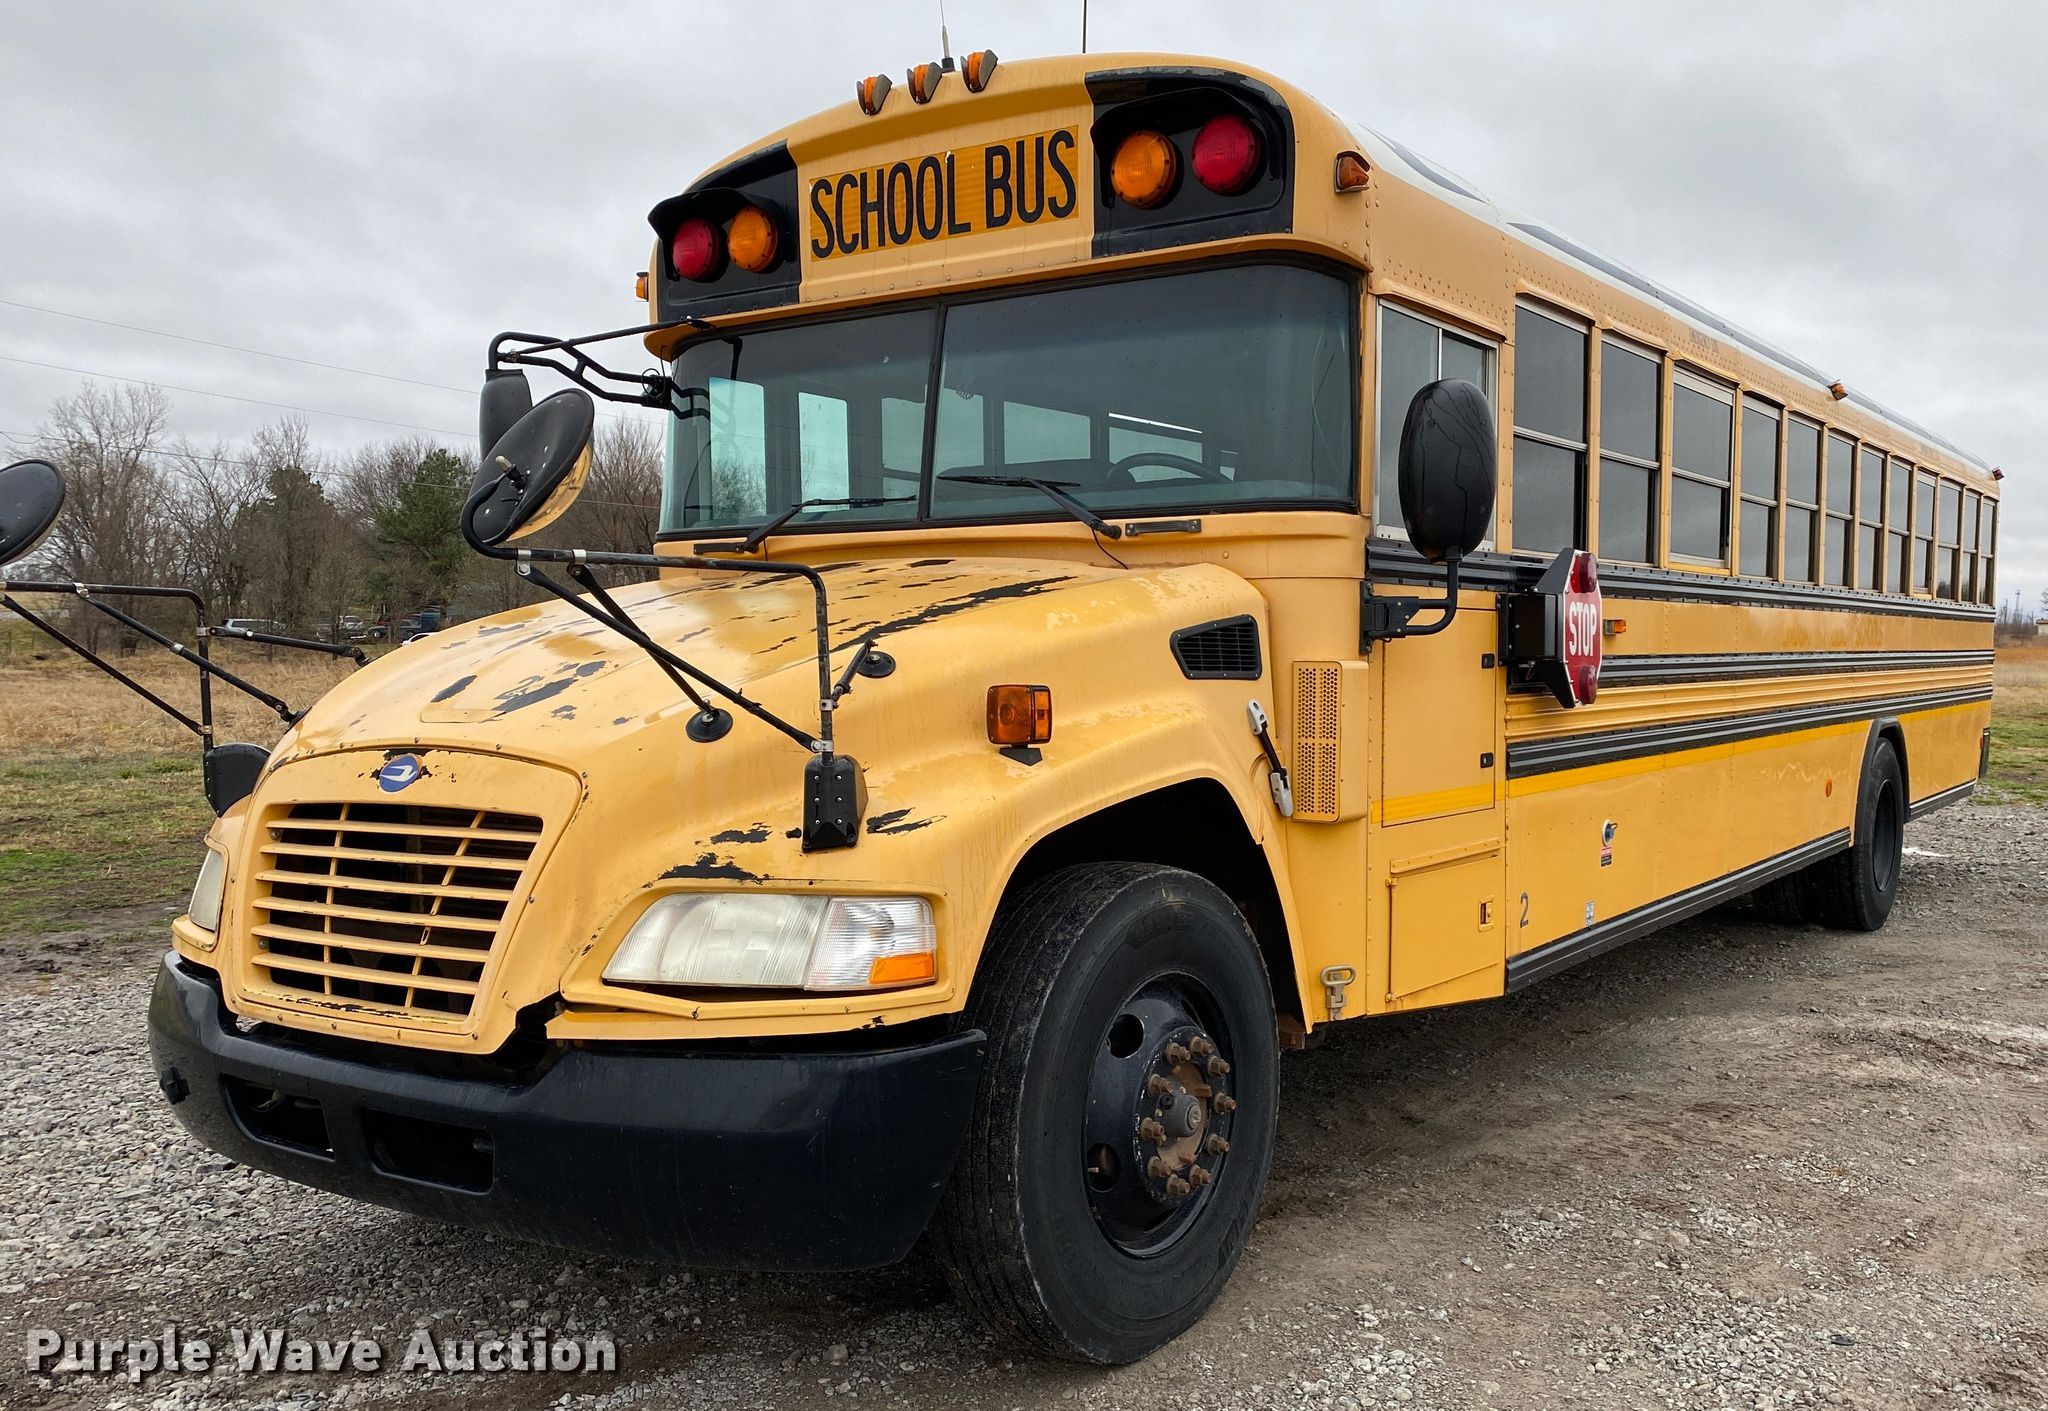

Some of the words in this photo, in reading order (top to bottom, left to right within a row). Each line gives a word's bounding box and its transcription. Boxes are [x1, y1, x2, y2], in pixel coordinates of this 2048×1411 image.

[811, 153, 971, 259] SCHOOL
[985, 129, 1077, 229] BUS
[1569, 601, 1597, 657] STOP
[1520, 892, 1529, 928] 2
